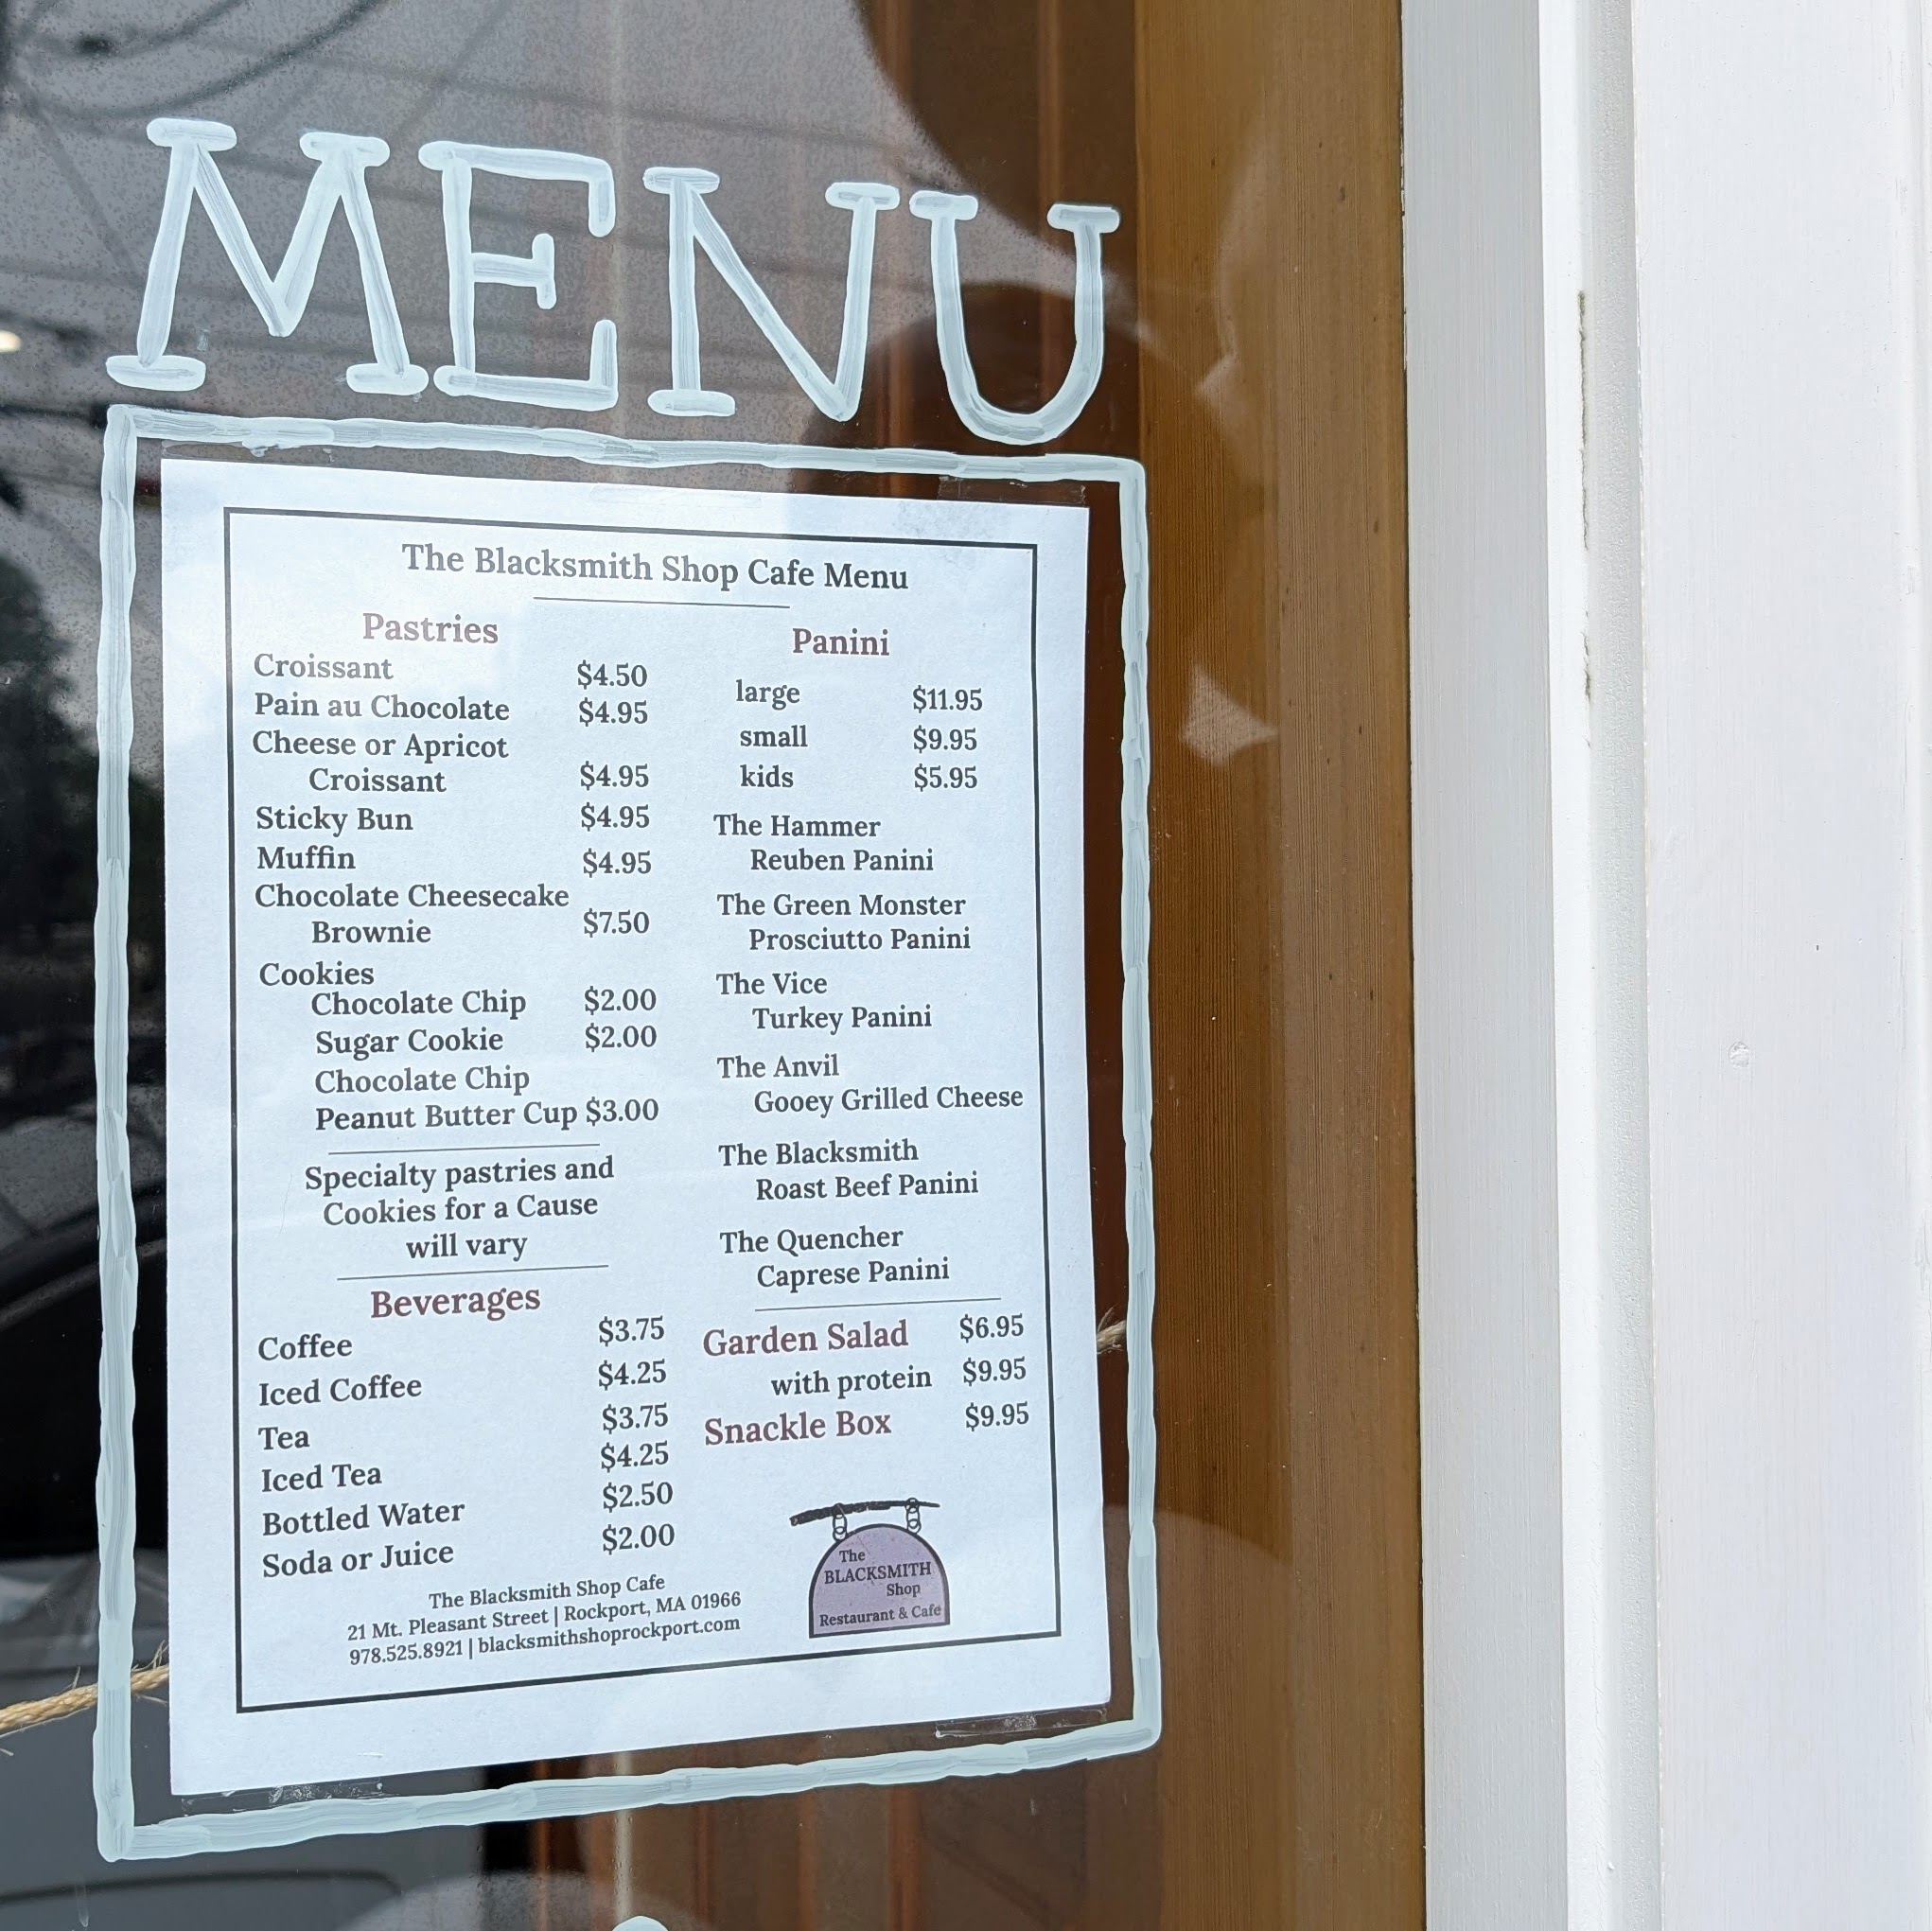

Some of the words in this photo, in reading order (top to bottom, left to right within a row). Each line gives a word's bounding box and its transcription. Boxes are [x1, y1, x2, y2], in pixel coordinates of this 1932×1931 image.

[106, 117, 1122, 446] MENU
[401, 542, 464, 571] The
[474, 546, 653, 580] Blacksmith
[661, 554, 738, 591] Shop
[747, 558, 814, 586] Cafe
[823, 562, 908, 589] Menu
[362, 612, 498, 643] Pastries
[792, 626, 889, 656] Panini
[254, 652, 394, 679] Croissant
[576, 658, 647, 690] $4.50
[254, 691, 320, 716] Pain
[327, 699, 361, 717] au
[370, 693, 509, 720] Chocolate
[735, 678, 799, 711] large
[912, 684, 982, 713] $11.95
[578, 696, 648, 727] $4.95
[252, 729, 356, 755] Cheese
[364, 738, 396, 755] or
[403, 732, 509, 764] Apricot
[739, 724, 808, 747] small
[912, 724, 977, 754] $9.95
[308, 766, 447, 792] Croissant
[579, 760, 649, 791] $4.95
[739, 764, 794, 788] kids
[913, 763, 977, 792] $5.95
[255, 804, 348, 837] Sticky
[357, 807, 413, 830] Bun
[580, 800, 649, 832] $4.95
[712, 812, 762, 836] The
[770, 814, 881, 836] Hammer
[256, 844, 356, 869] Muffin
[582, 847, 651, 878] $4.95
[749, 847, 845, 870] Reuben
[852, 847, 934, 870] Panini
[255, 882, 398, 907] Chocolate
[407, 882, 569, 907] Cheesecake
[716, 891, 765, 916] The
[773, 893, 852, 916] Green
[858, 893, 966, 915] Monster
[311, 918, 430, 943] Brownie
[583, 907, 649, 938] $7.50
[748, 926, 882, 950] Prosciutto
[890, 925, 971, 949] Panini
[258, 959, 374, 986] Cookies
[715, 971, 764, 994] The
[771, 970, 827, 994] Vice
[310, 990, 452, 1016] Chocolate
[461, 988, 526, 1020] Chip
[584, 985, 657, 1015] $2.00
[751, 1005, 843, 1036] Turkey
[851, 1003, 932, 1027] Panini
[315, 1030, 399, 1061] Sugar
[407, 1026, 503, 1052] Cookie
[585, 1022, 657, 1053] $2.00
[314, 1066, 456, 1094] Chocolate
[465, 1063, 529, 1096] Chip
[716, 1054, 765, 1079] The
[772, 1052, 839, 1078] Anvil
[315, 1107, 416, 1131] Peanut
[425, 1104, 516, 1127] Butter
[523, 1100, 577, 1131] Cup
[586, 1096, 659, 1127] $3.00
[753, 1090, 834, 1118] Gooey
[841, 1085, 928, 1111] Grilled
[936, 1084, 1023, 1108] Cheese
[717, 1142, 767, 1167] The
[775, 1137, 919, 1165] Blacksmith
[305, 1161, 436, 1197] Specialty
[444, 1156, 556, 1192] pastries
[564, 1153, 614, 1180] and
[755, 1178, 827, 1201] Roast
[834, 1172, 892, 1198] Beef
[898, 1169, 978, 1195] Panini
[323, 1197, 436, 1225] Cookies
[444, 1195, 485, 1220] for
[493, 1201, 509, 1219] a
[517, 1194, 598, 1218] Cause
[405, 1232, 458, 1258] will
[465, 1237, 528, 1262] vary
[718, 1229, 768, 1254] The
[777, 1224, 904, 1257] Quencher
[756, 1264, 860, 1293] Caprese
[868, 1255, 949, 1282] Panini
[370, 1287, 540, 1321] Beverages
[598, 1314, 664, 1347] $3.75
[702, 1325, 817, 1356] Garden
[827, 1318, 908, 1350] Salad
[959, 1312, 1024, 1343] $6.95
[257, 1332, 352, 1360] Coffee
[598, 1358, 666, 1391] $4.25
[770, 1369, 830, 1396] with
[836, 1363, 932, 1399] protein
[962, 1355, 1026, 1387] $9.95
[258, 1378, 321, 1406] Iced
[329, 1373, 422, 1402] Coffee
[602, 1401, 668, 1434] $3.75
[704, 1411, 825, 1446] Snackle
[835, 1410, 891, 1436] Box
[965, 1400, 1028, 1431] $9.95
[257, 1426, 309, 1450] Tea
[600, 1439, 669, 1473] $4.25
[261, 1463, 324, 1492] Iced
[331, 1463, 382, 1487] Tea
[602, 1480, 673, 1513] $2.50
[262, 1502, 370, 1536] Bottled
[377, 1501, 465, 1527] Water
[602, 1522, 675, 1555] $2.00
[262, 1549, 332, 1577] Soda
[341, 1552, 373, 1571] or
[379, 1539, 453, 1569] Juice
[838, 1548, 865, 1563] The
[824, 1561, 931, 1584] BLACKSMITH
[428, 1591, 464, 1609] The
[469, 1581, 571, 1606] Blacksmith
[575, 1579, 621, 1598] Shop
[625, 1573, 665, 1592] Cafe
[886, 1582, 921, 1598] Shop
[347, 1624, 365, 1641] 21
[372, 1622, 402, 1639] Mt.
[408, 1614, 487, 1635] Pleasant
[492, 1609, 549, 1627] Street
[563, 1600, 650, 1622] Rockport,
[656, 1595, 686, 1613] MA
[691, 1590, 741, 1609] 01966
[819, 1608, 895, 1626] Restaurant
[898, 1606, 908, 1619] &
[910, 1603, 941, 1618] Cafe
[349, 1639, 463, 1665] 978.525.8921
[477, 1616, 740, 1654] blacksmithshoprockport.com
